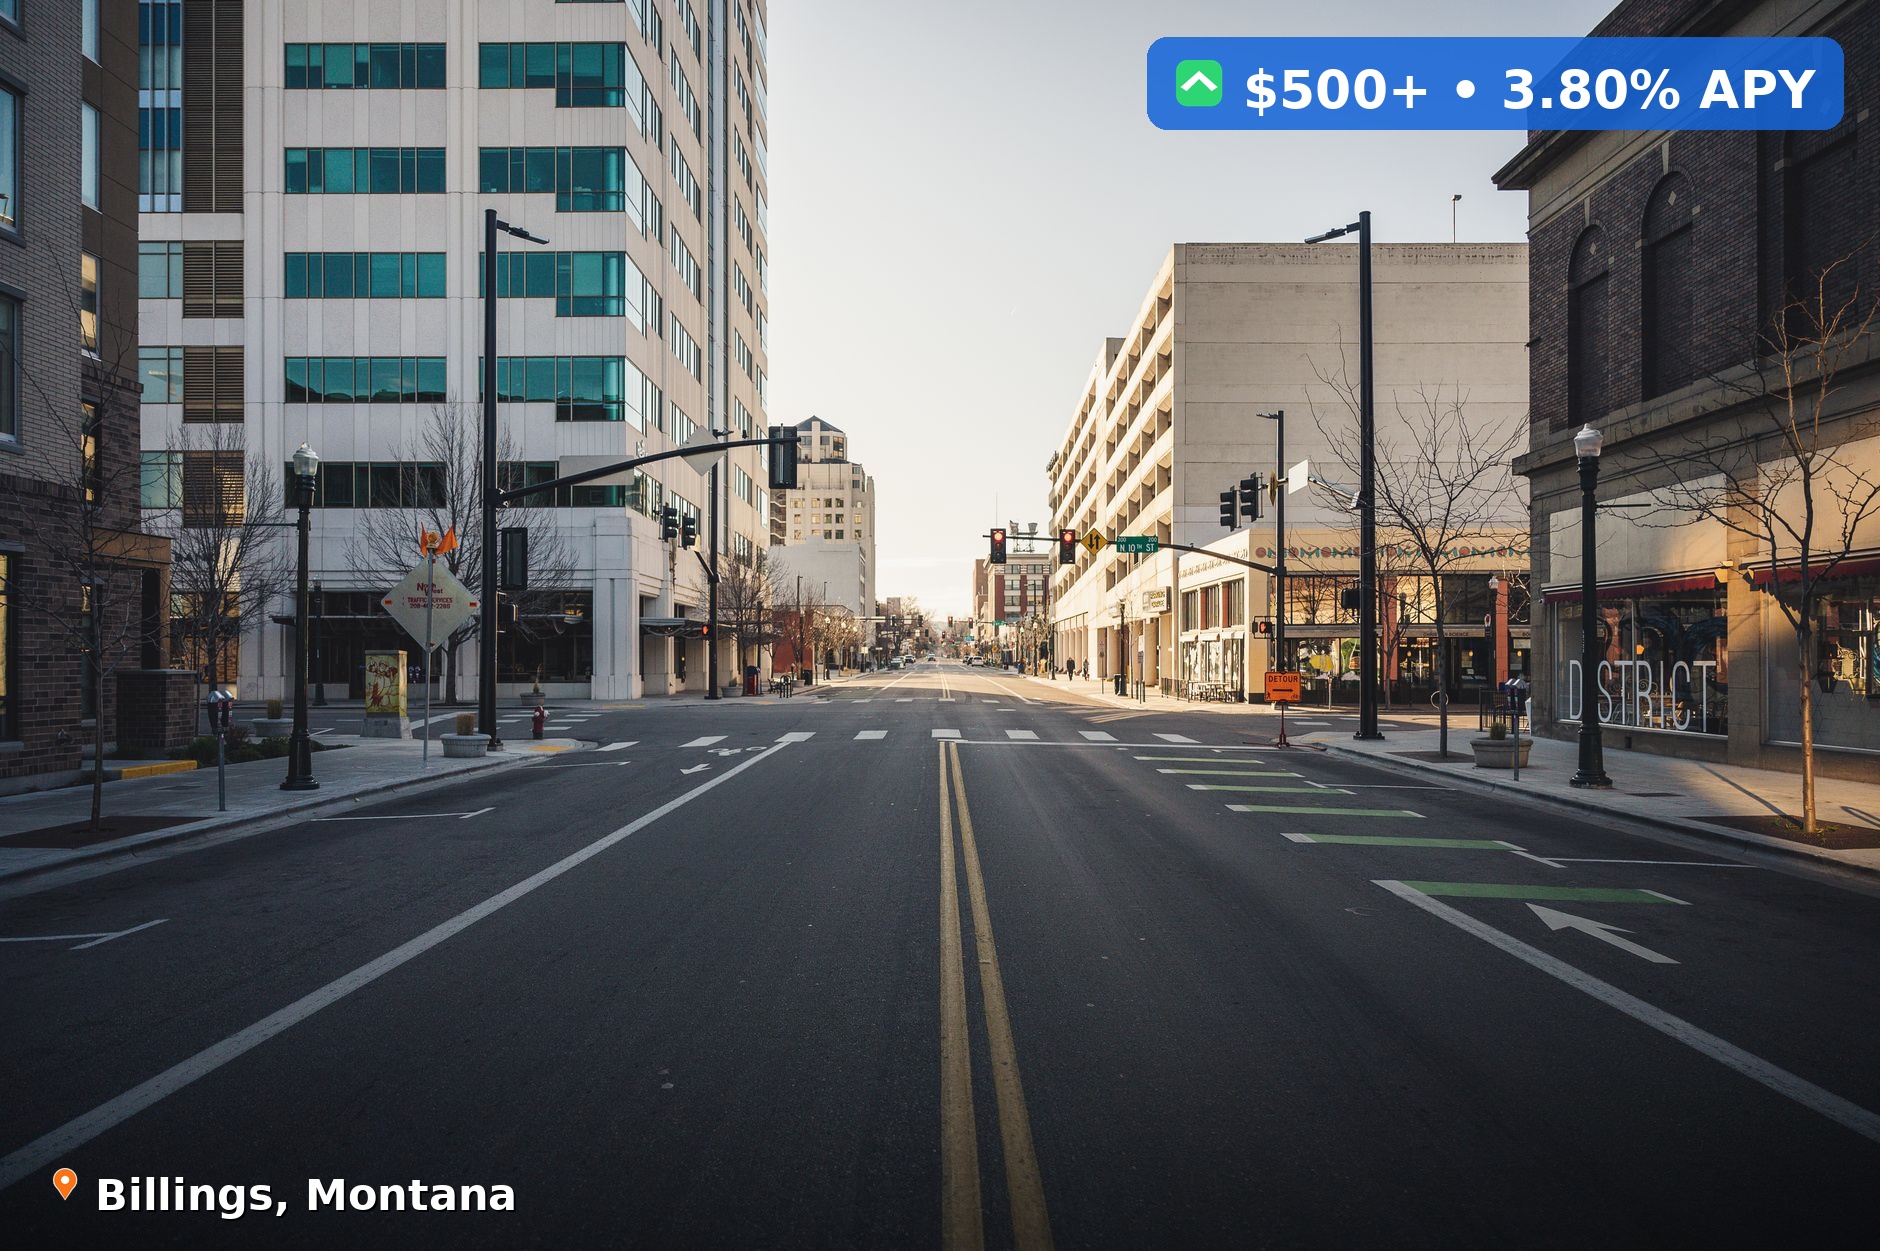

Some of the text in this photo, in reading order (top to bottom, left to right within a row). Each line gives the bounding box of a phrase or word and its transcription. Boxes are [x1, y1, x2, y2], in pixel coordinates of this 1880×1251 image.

[1119, 544, 1125, 552] N
[1145, 543, 1155, 552] ST
[1268, 675, 1299, 683] DETOUR
[1569, 660, 1717, 733] DSTRICT
